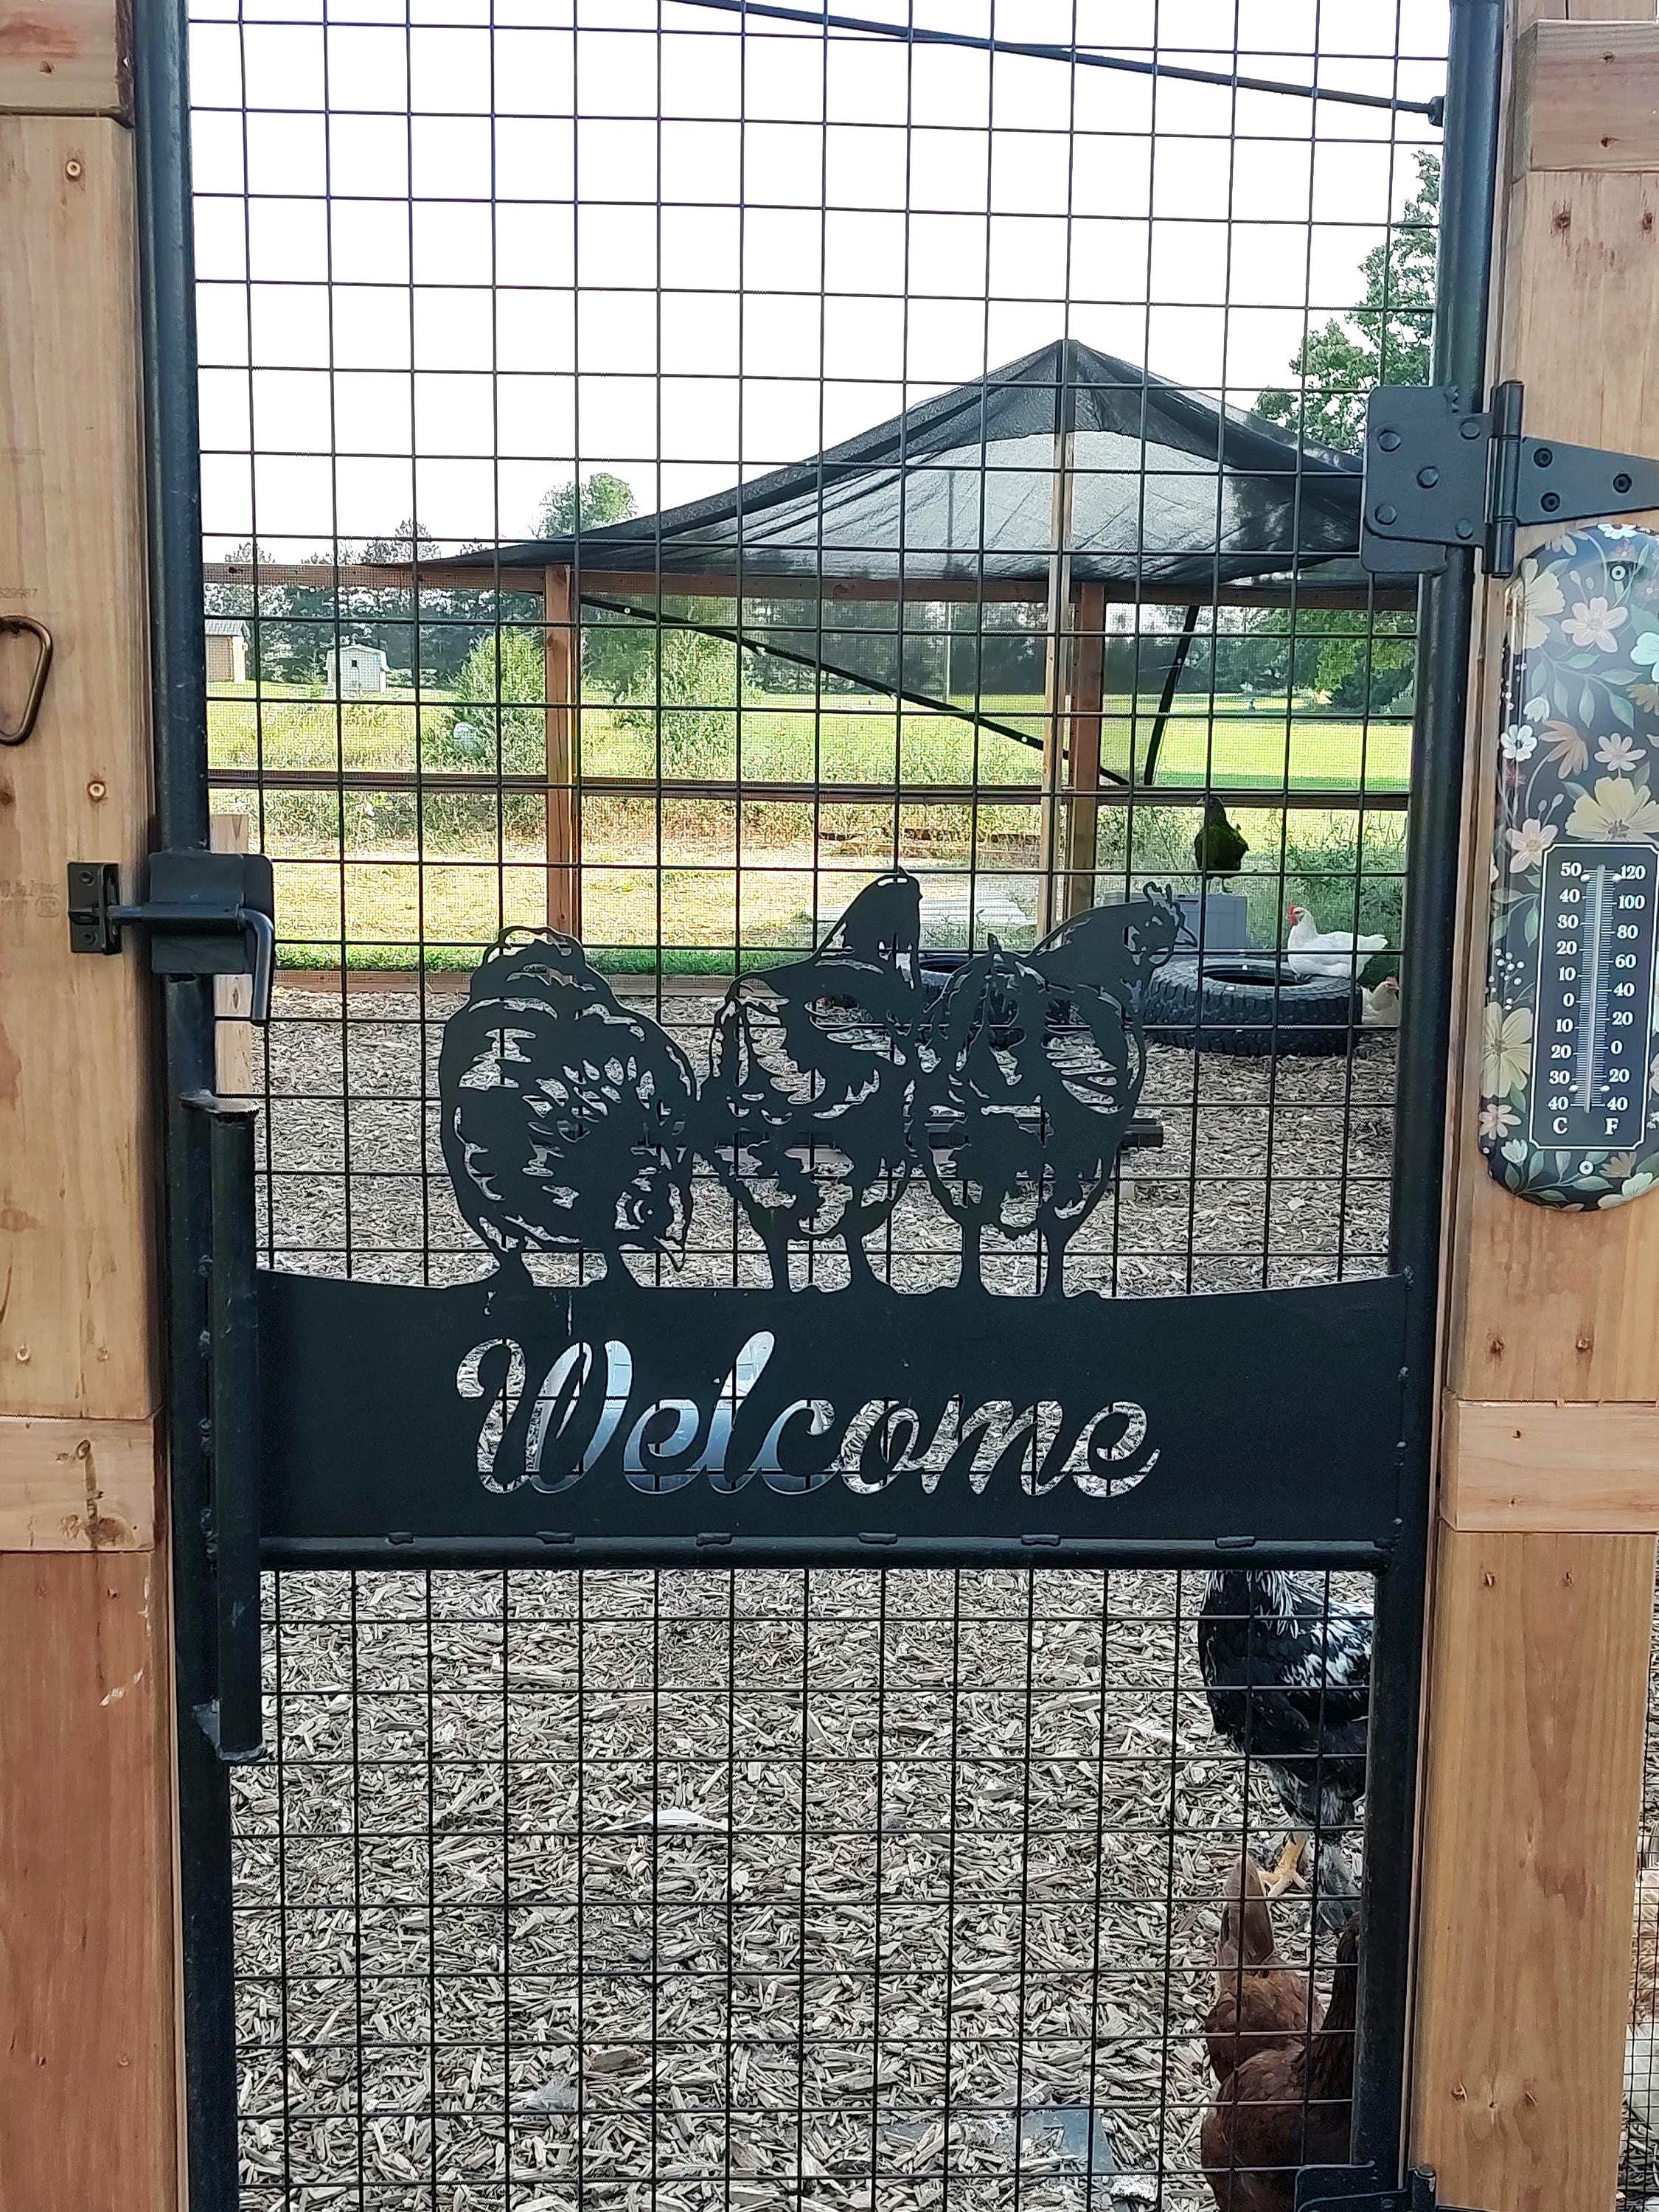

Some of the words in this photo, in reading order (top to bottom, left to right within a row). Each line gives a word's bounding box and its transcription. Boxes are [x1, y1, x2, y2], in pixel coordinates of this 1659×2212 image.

[1560, 862, 1582, 877] 50
[1621, 865, 1646, 880] 120
[1559, 888, 1580, 903] 40
[1618, 894, 1646, 910] 100
[1557, 914, 1579, 929] 30
[1617, 925, 1638, 939] 80
[1556, 940, 1577, 955] 20
[1615, 954, 1637, 968] 60
[1558, 967, 1576, 981] 10
[1613, 982, 1635, 997] 40
[1562, 992, 1575, 1007] 0
[1556, 1018, 1573, 1032] 10
[1612, 1011, 1633, 1026] 20
[1551, 1044, 1572, 1059] 20
[1610, 1040, 1623, 1054] 0
[1549, 1070, 1571, 1085] 30
[1609, 1068, 1630, 1082] 20
[1548, 1096, 1569, 1110] 40
[1607, 1096, 1628, 1110] 40
[1553, 1116, 1568, 1134] C
[1604, 1117, 1619, 1135] F
[456, 1331, 1161, 1498] Welcome
